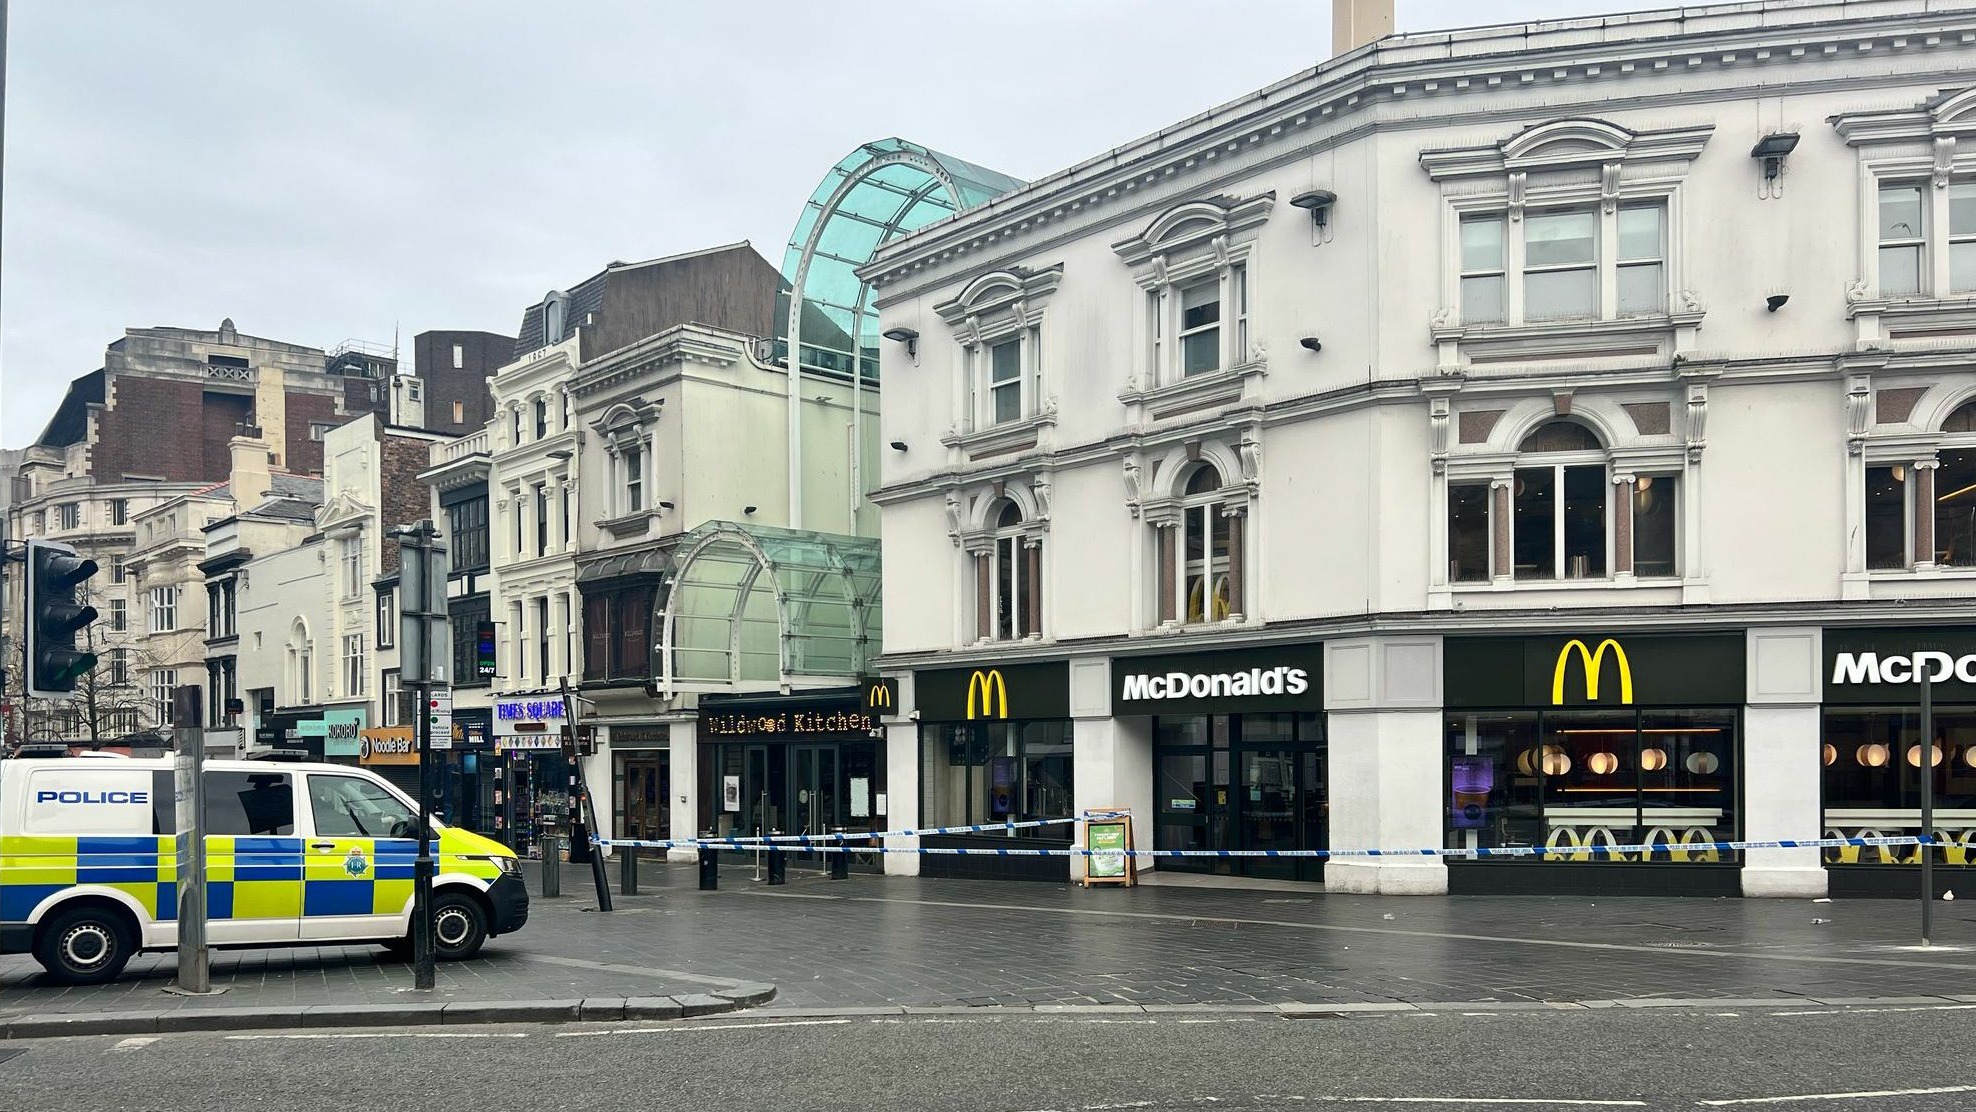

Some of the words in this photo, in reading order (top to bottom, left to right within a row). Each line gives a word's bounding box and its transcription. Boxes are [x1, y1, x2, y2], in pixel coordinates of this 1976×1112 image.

[1122, 666, 1308, 701] McDonald's
[497, 703, 524, 720] TIMES
[527, 700, 566, 721] SQUARE
[328, 724, 357, 738] KOKORO
[708, 713, 786, 734] Wildwood
[794, 711, 872, 732] Kitchen
[372, 738, 396, 753] Noodle
[397, 737, 411, 752] Bar
[37, 791, 148, 804] POLICE
